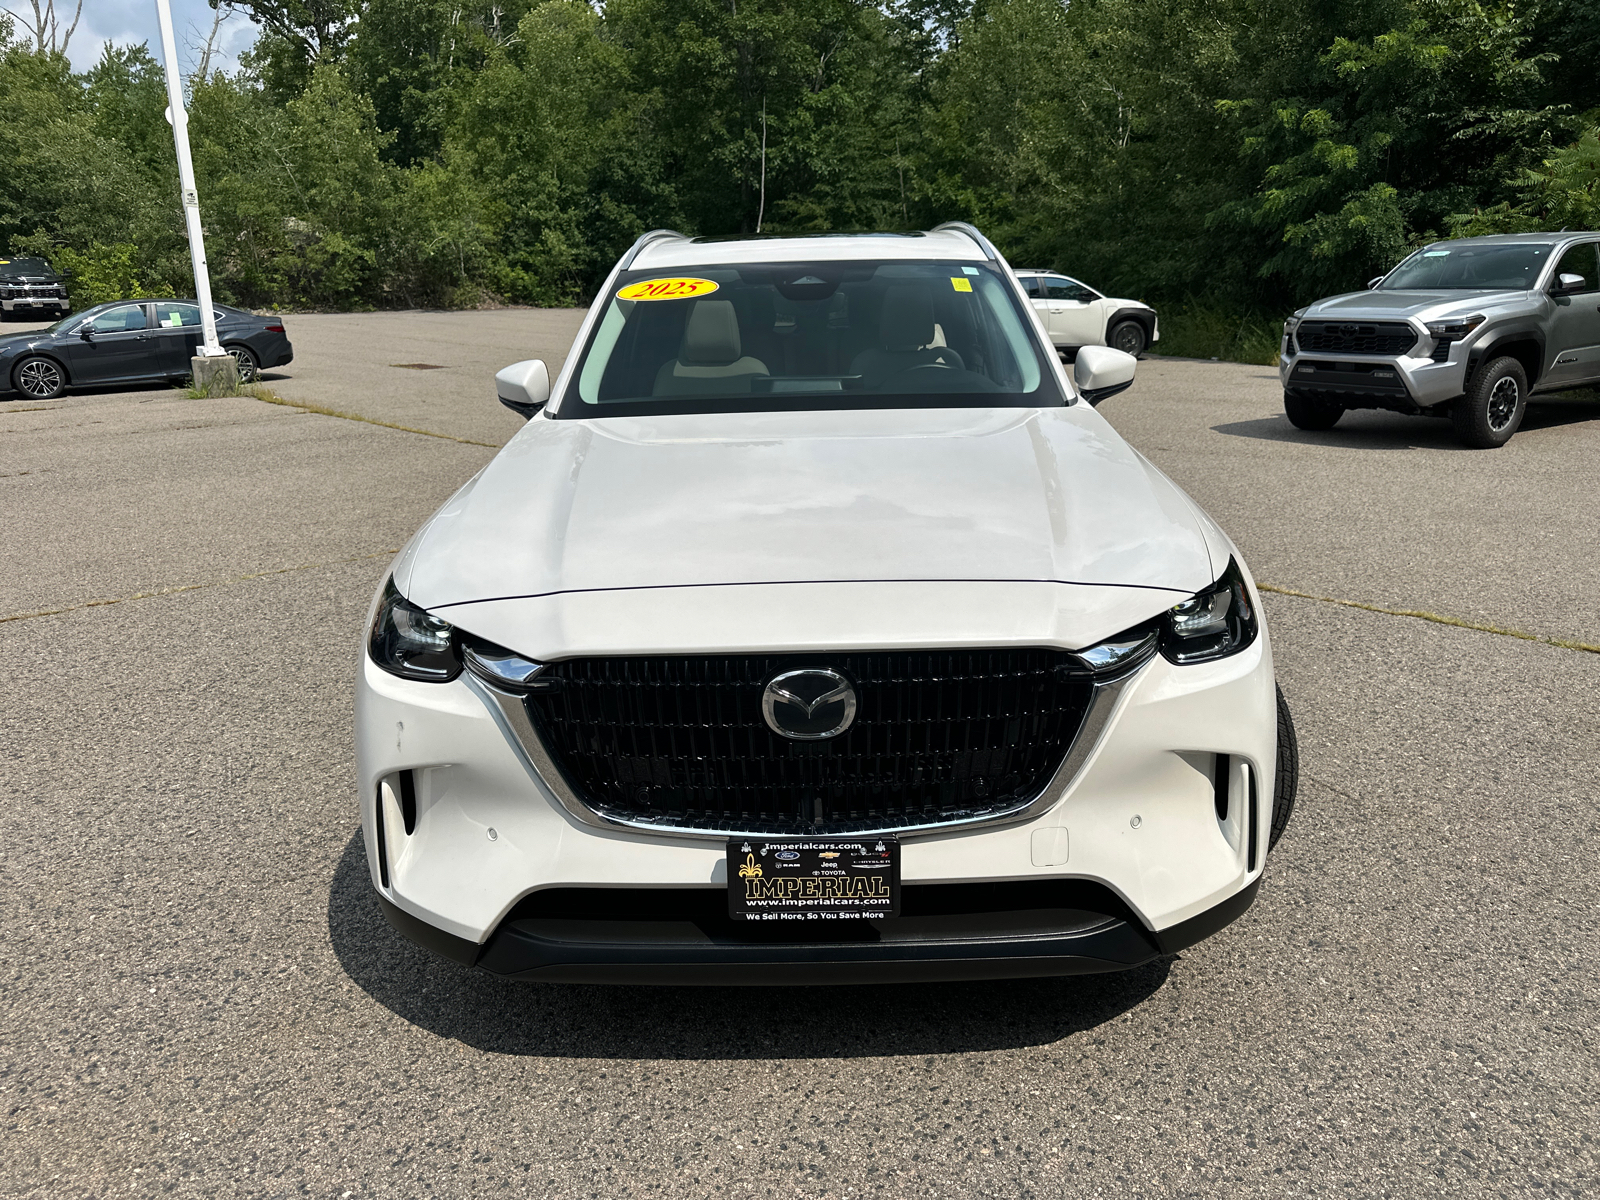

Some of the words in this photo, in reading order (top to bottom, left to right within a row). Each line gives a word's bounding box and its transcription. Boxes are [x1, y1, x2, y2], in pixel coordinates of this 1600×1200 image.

[631, 282, 704, 297] 2025
[765, 843, 861, 851] Imperialcars.com
[745, 877, 889, 898] IMPERIAL
